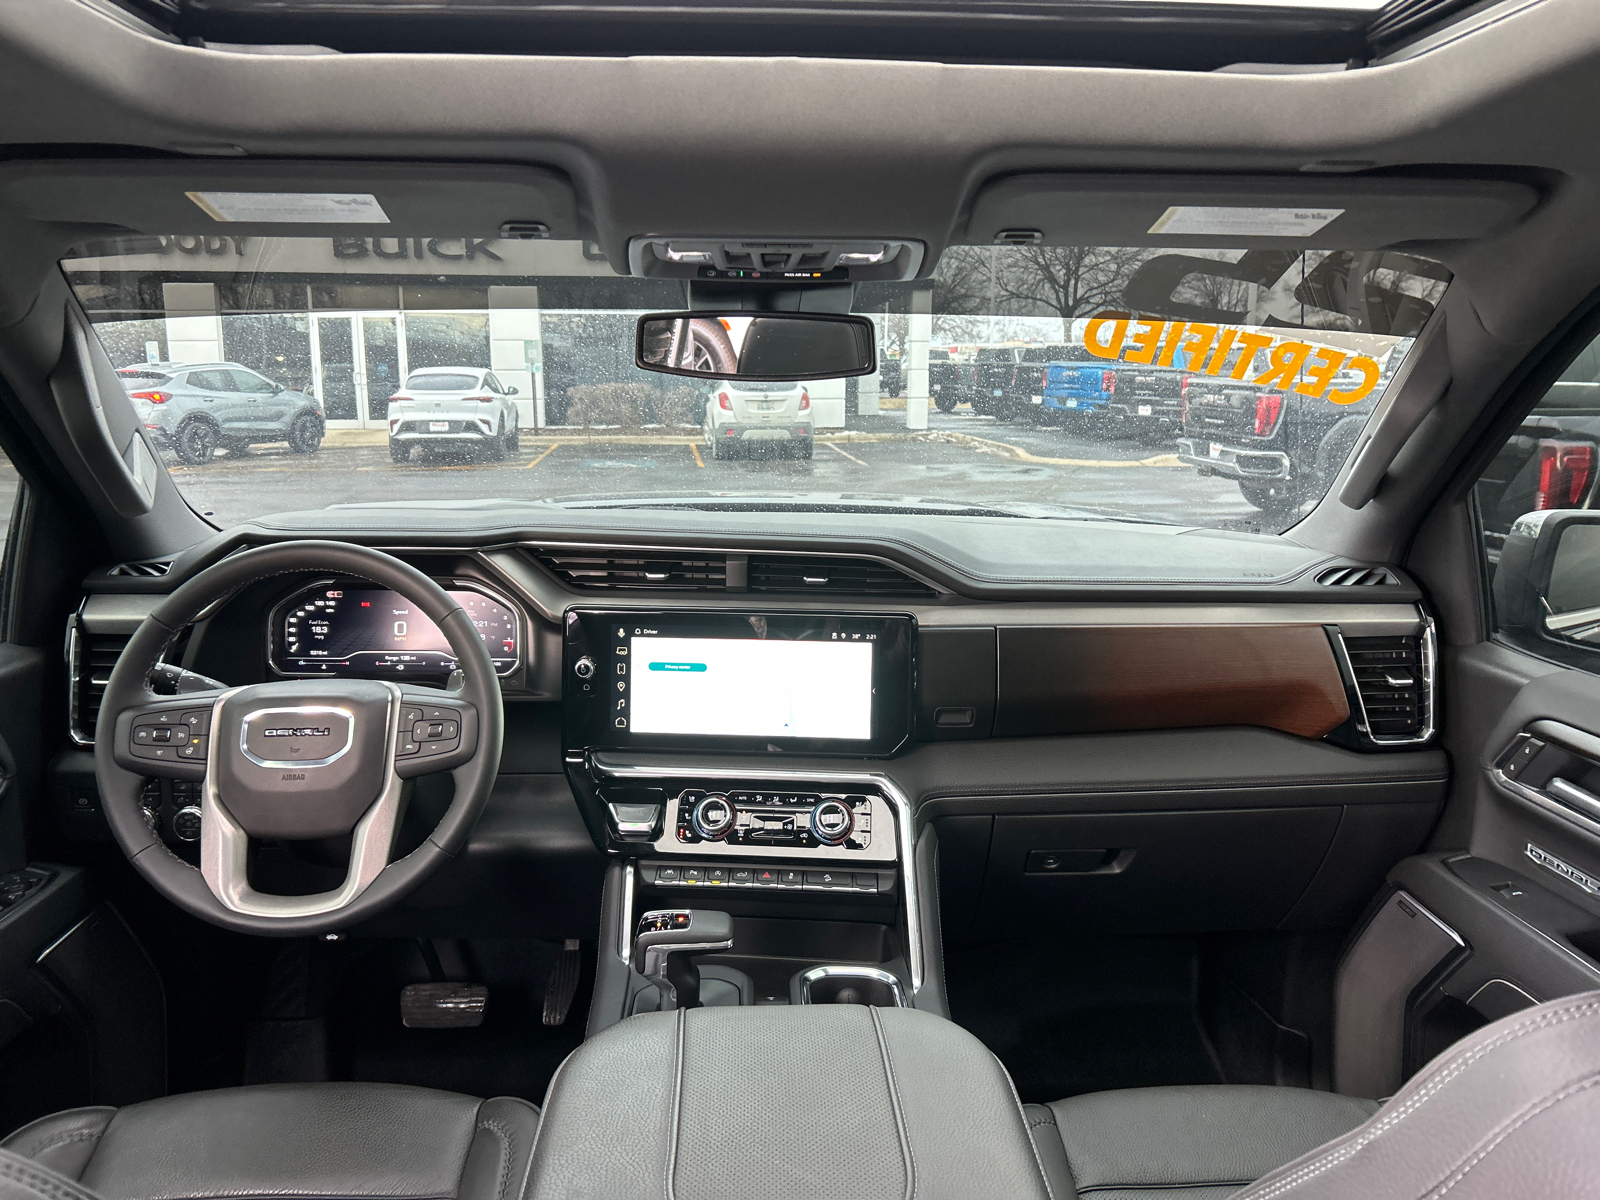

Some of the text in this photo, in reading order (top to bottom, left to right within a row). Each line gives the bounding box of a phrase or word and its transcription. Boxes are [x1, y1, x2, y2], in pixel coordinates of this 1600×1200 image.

[333, 236, 503, 261] BUICK
[394, 621, 407, 636] 0
[264, 727, 331, 738] DENALI
[281, 773, 306, 782] AIRBAG
[1529, 848, 1600, 893] DENAL
